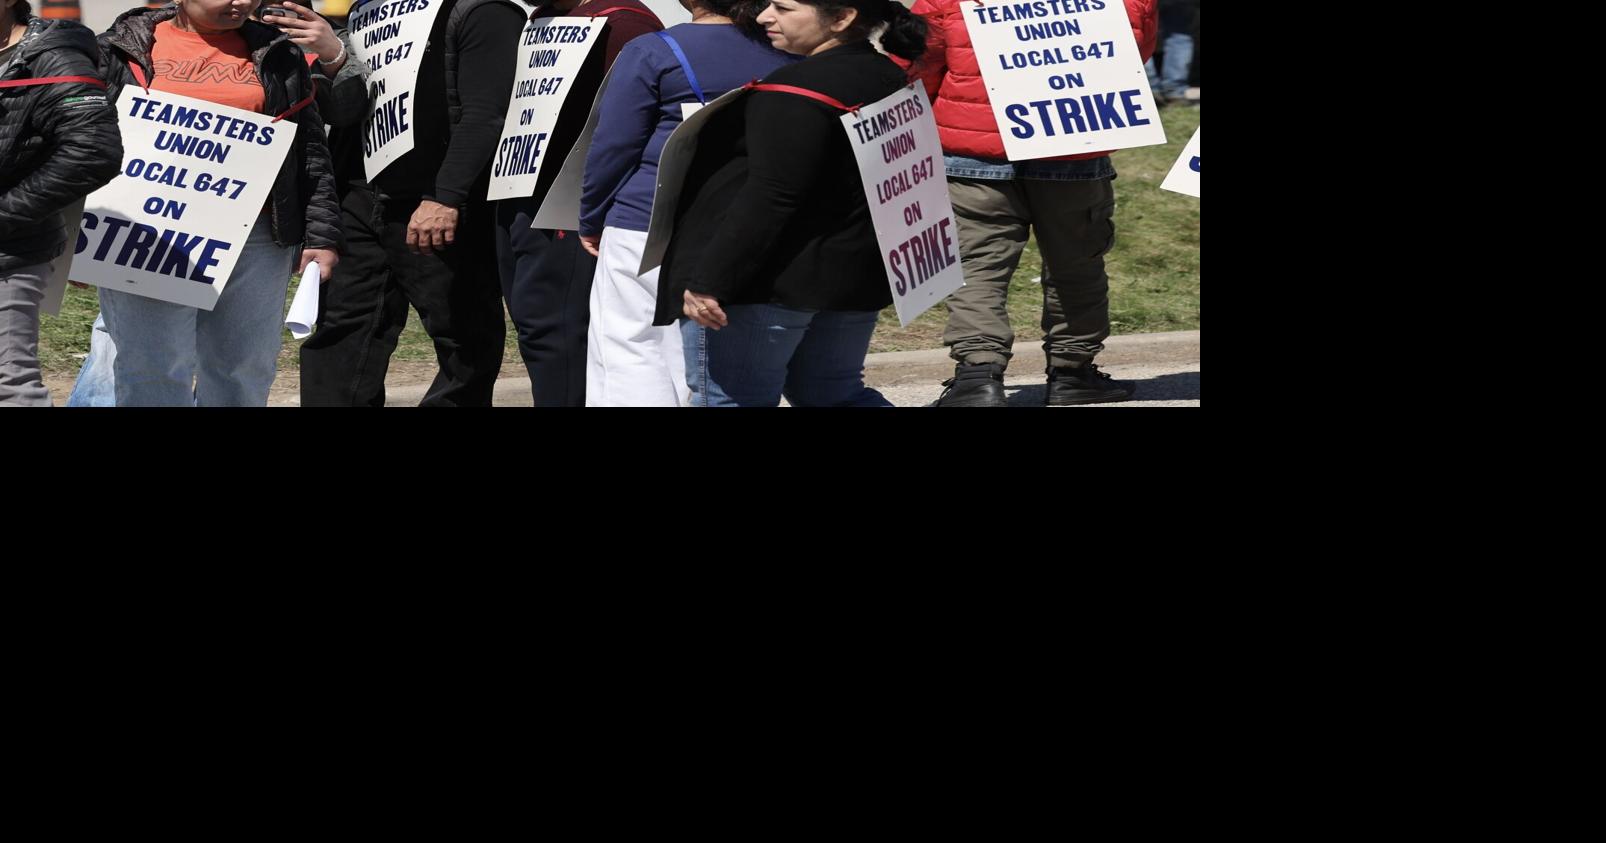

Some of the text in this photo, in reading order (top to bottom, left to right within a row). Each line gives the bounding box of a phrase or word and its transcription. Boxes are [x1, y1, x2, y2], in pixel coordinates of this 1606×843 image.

[352, 0, 430, 34] TEAMSTERS
[973, 0, 1106, 24] TEAMSTERS
[364, 20, 401, 49] UNION
[523, 25, 591, 46] TEAMSTERS
[1015, 19, 1081, 41] UNION
[385, 41, 413, 66] 647
[528, 49, 561, 68] UNION
[999, 40, 1115, 71] LOCAL 647
[373, 78, 386, 100] ON
[515, 76, 564, 99] LOCAL 647
[1047, 72, 1085, 90] ON
[128, 97, 275, 146] TEAMSTERS
[365, 91, 410, 159] STRIKE
[519, 108, 534, 125] ON
[853, 94, 923, 145] TEAMSTERS
[1004, 88, 1151, 140] STRIKE
[154, 130, 231, 164] UNION
[494, 133, 547, 178] STRIKE
[881, 129, 916, 164] UNION
[120, 159, 247, 200] OCAL 647
[876, 156, 934, 205] LOCAL 647
[143, 196, 187, 220] ON
[903, 201, 922, 226] ON
[74, 212, 232, 285] STRIKE
[888, 217, 957, 297] STRIKE
